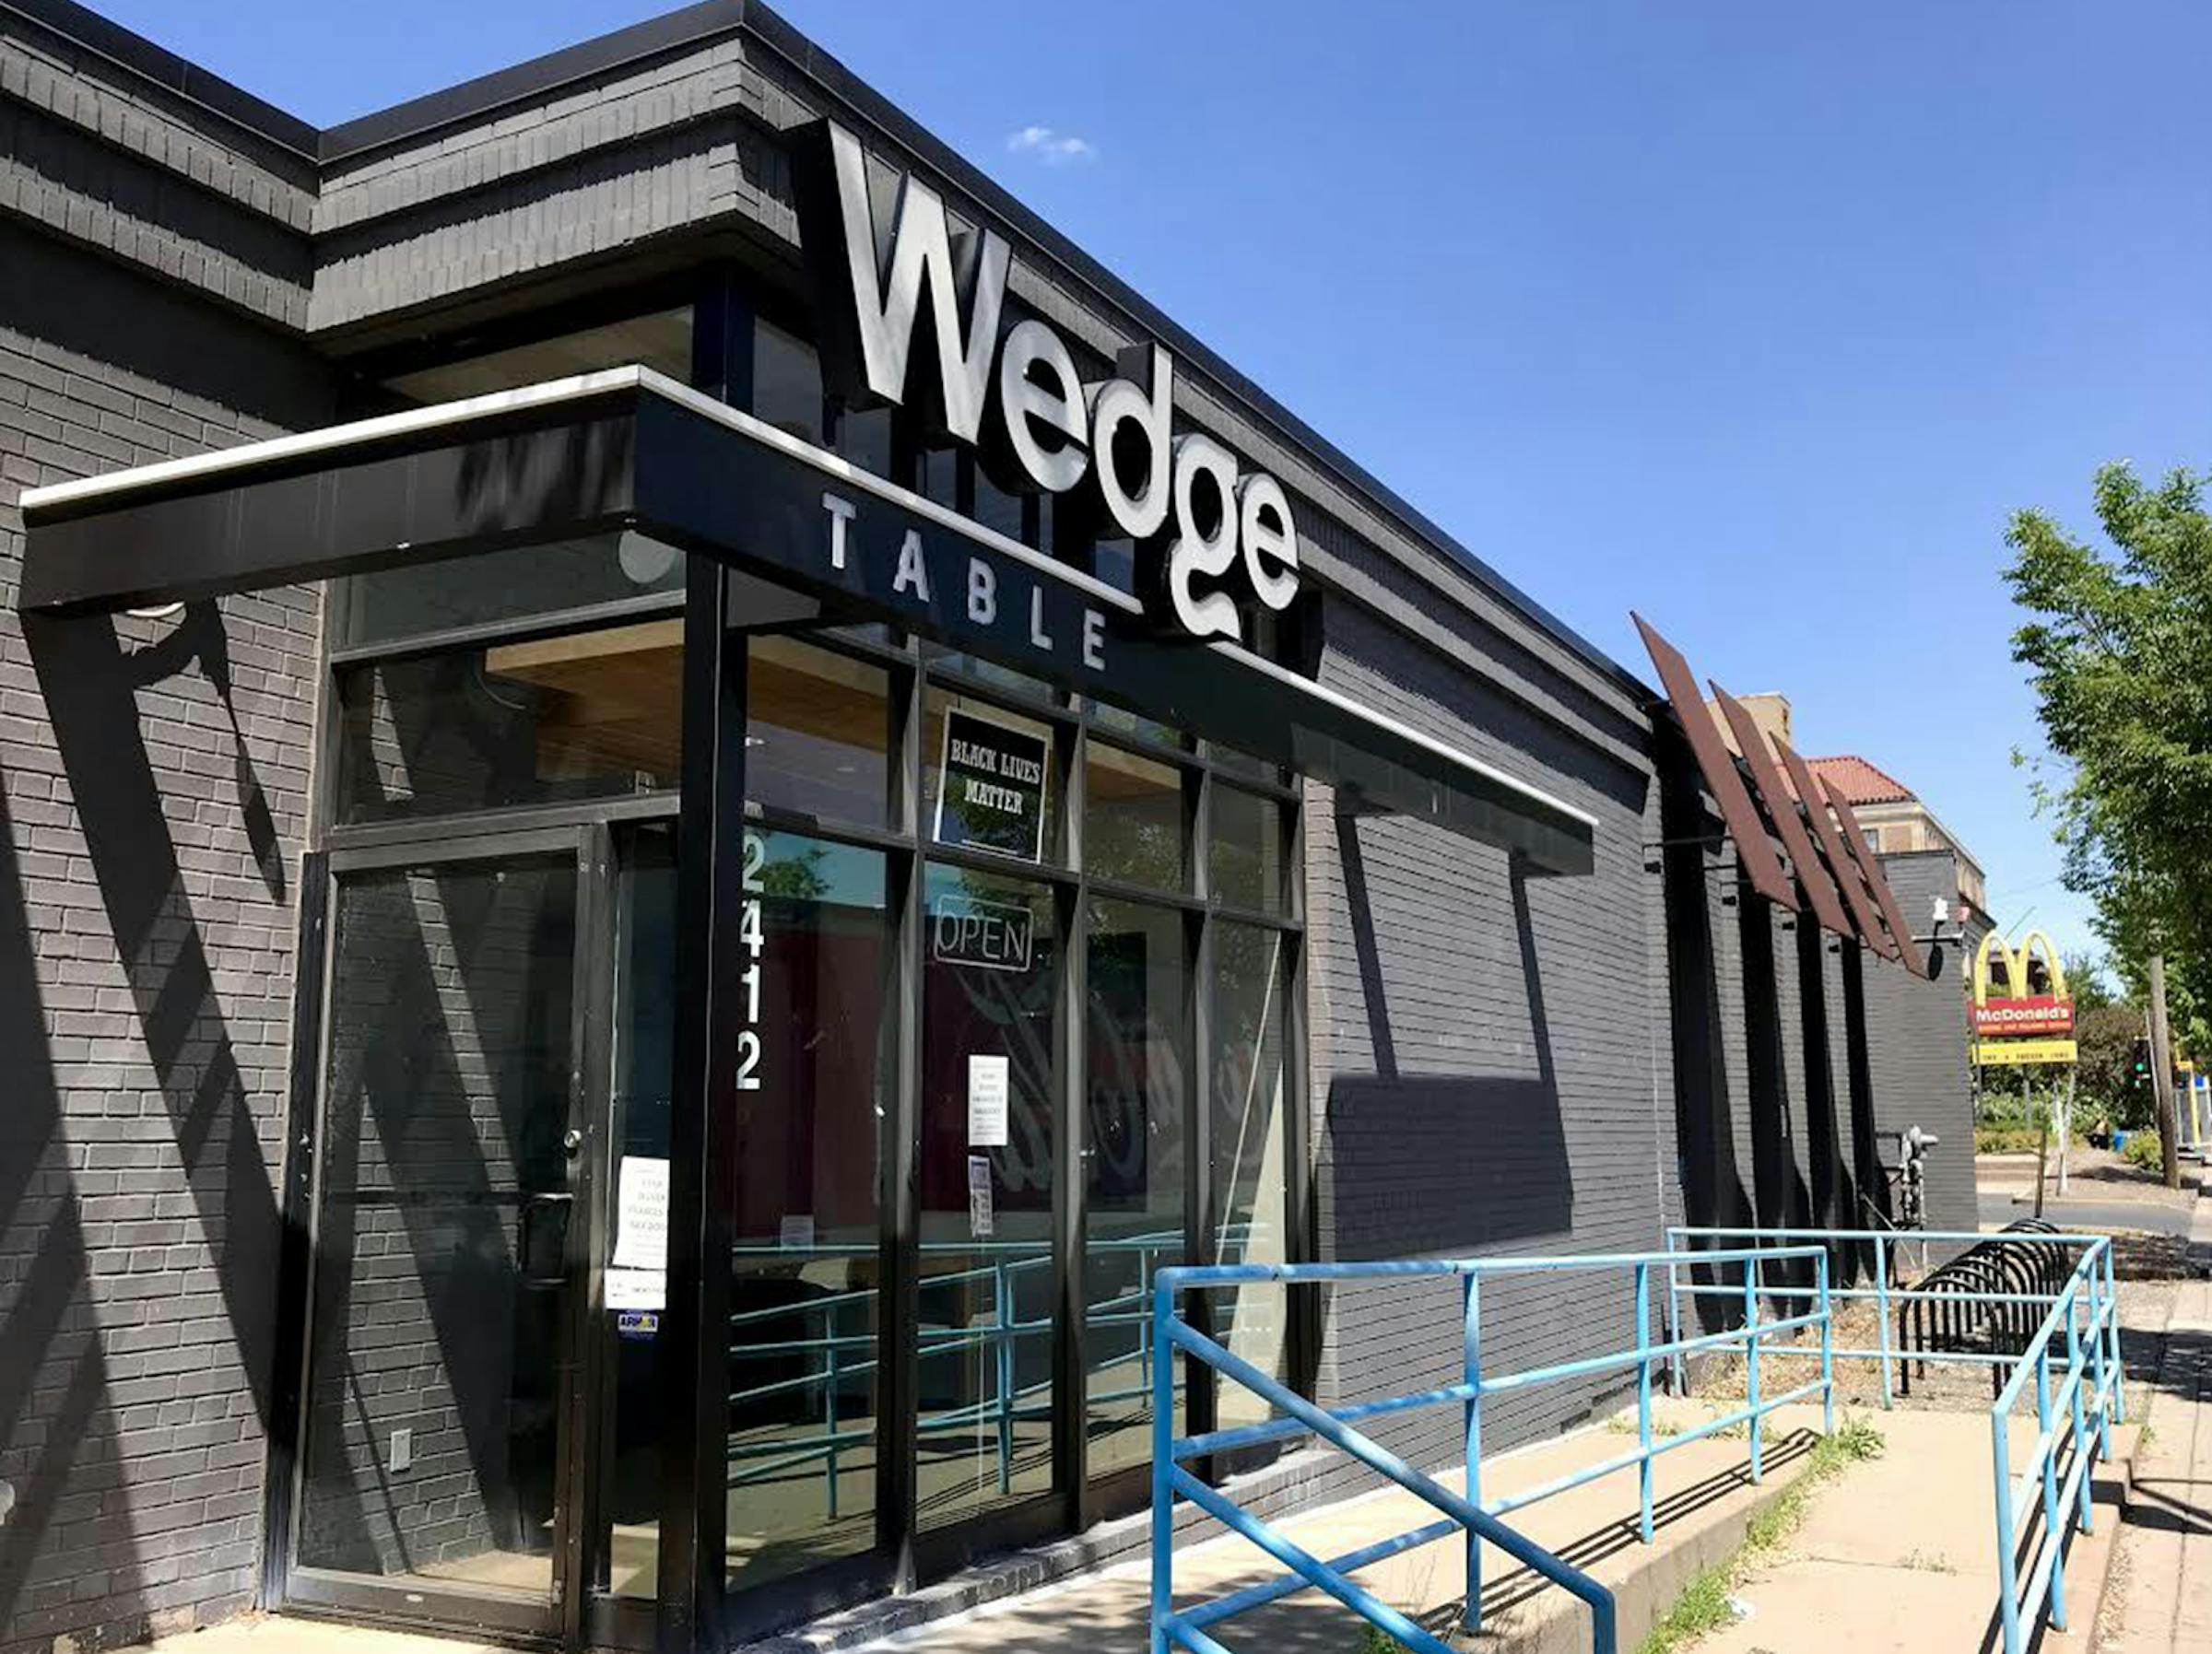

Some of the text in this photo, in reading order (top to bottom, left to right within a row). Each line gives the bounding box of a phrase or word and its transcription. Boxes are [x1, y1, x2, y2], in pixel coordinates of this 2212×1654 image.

[830, 118, 1300, 642] Wedge
[822, 492, 1105, 672] TABLE
[950, 739, 1041, 785] BLACK LIVES
[964, 779, 1023, 815] MATTER
[736, 834, 765, 1090] 2412
[939, 911, 1026, 962] OPEN
[1975, 1006, 2069, 1022] McDonald's
